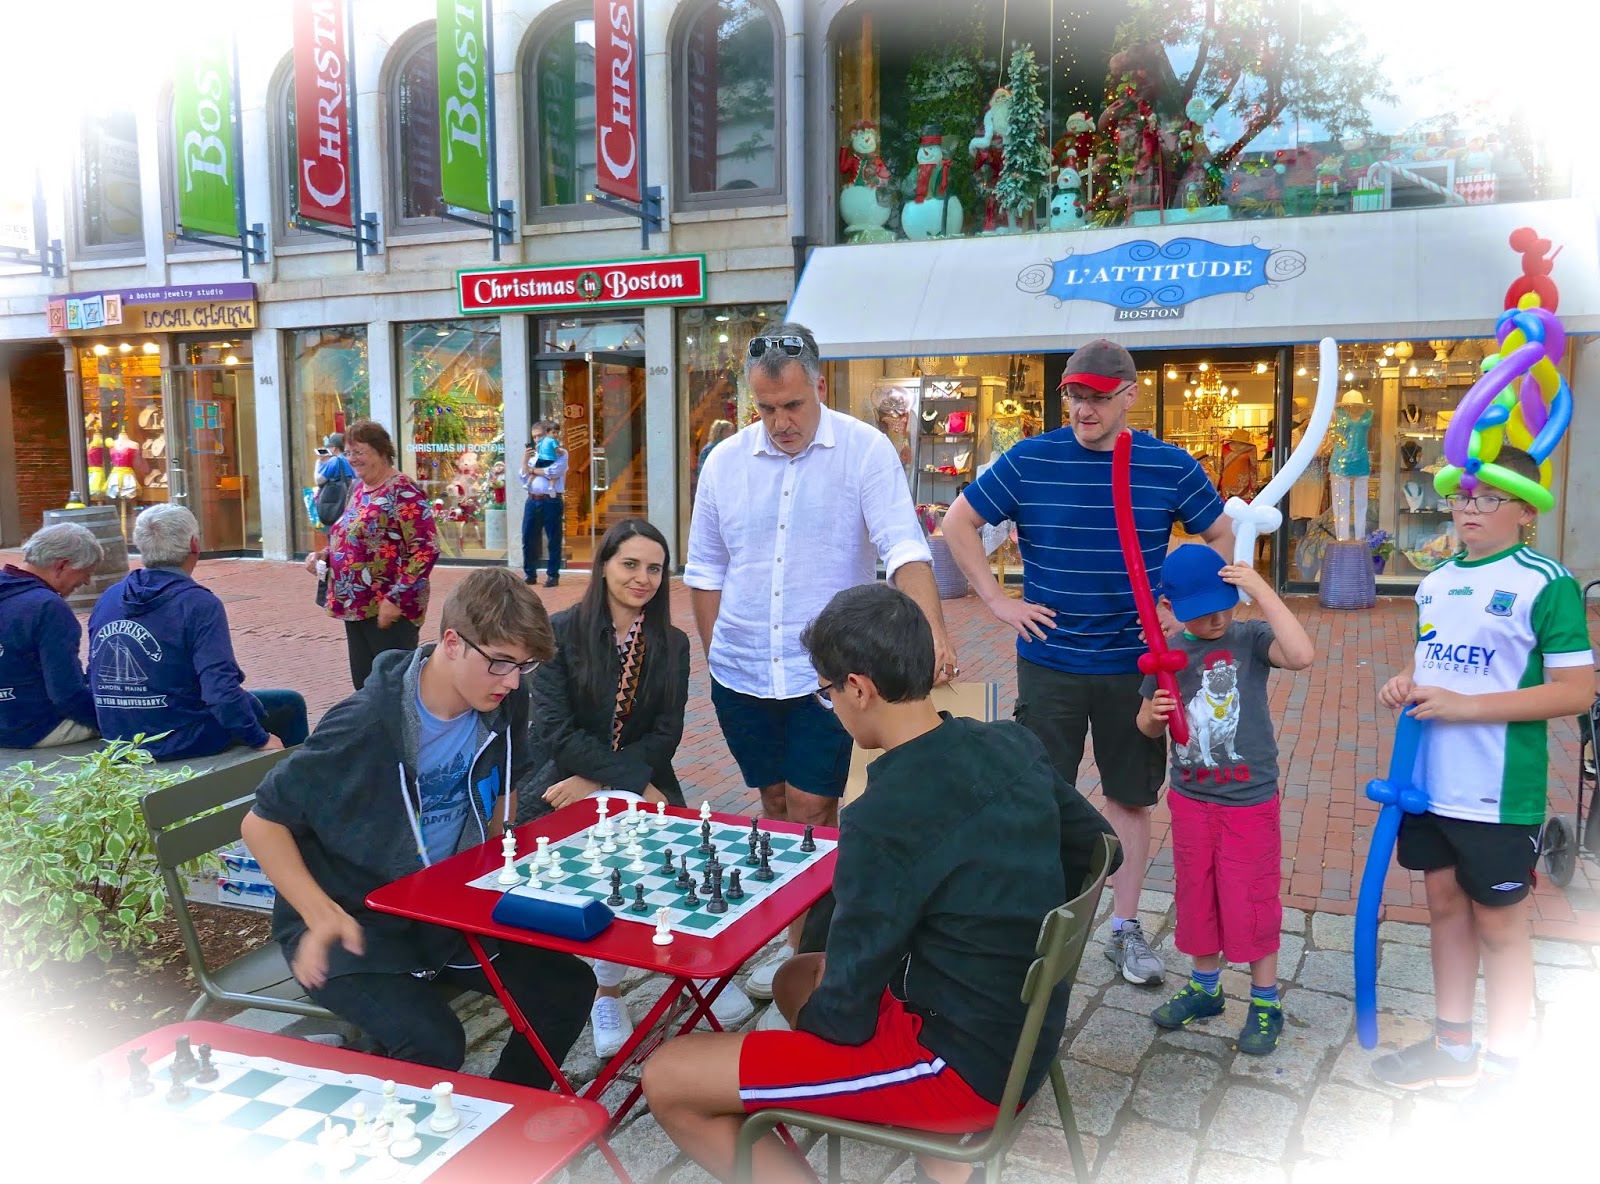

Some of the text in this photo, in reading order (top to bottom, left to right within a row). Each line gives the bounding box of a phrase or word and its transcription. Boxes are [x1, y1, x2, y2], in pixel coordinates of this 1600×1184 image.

[600, 1, 637, 181] CHRIS
[1065, 260, 1252, 285] L'ATTITUDE
[137, 292, 159, 300] boston
[164, 290, 193, 299] jewelry
[474, 271, 684, 304] Christmas in Boston
[143, 303, 252, 328] LOCAL CHARM
[1118, 308, 1181, 320] BOSTON
[406, 443, 505, 453] CHRISTMAS IN BOSTON
[98, 620, 151, 644] SURPRISE
[1425, 642, 1496, 667] TRACEY
[1422, 660, 1490, 676] CONCRETE
[117, 698, 161, 707] ANNIVERSARY
